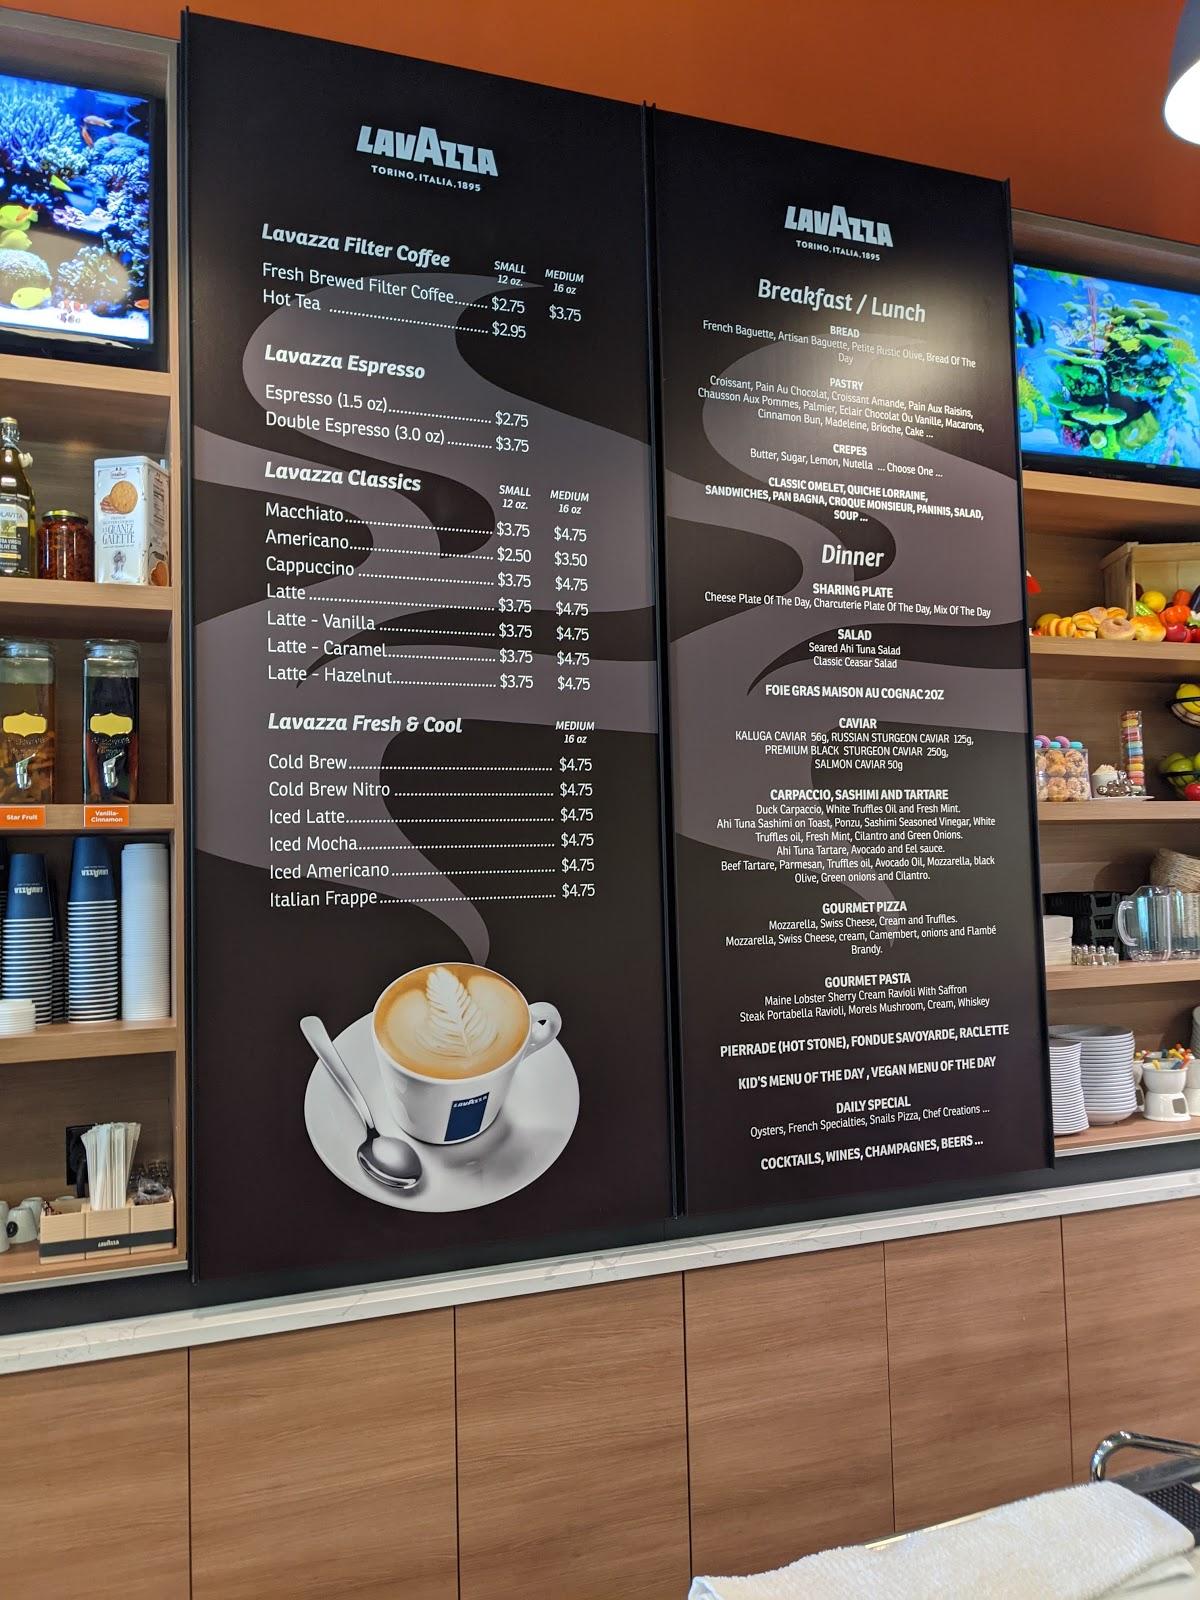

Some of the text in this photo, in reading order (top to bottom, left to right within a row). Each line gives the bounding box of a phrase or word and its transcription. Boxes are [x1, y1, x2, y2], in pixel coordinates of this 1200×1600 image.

[356, 125, 498, 177] LAVAZZA
[784, 205, 894, 248] LAVAZZA
[262, 223, 450, 268] Lavazza Filter Coffee
[494, 260, 526, 274] SMALL
[263, 262, 407, 296] Fresh Brewed Filter
[545, 269, 584, 283] MEDIUM
[263, 288, 321, 310] Hot Tea
[492, 296, 525, 314] $2.75
[758, 278, 925, 322] Breakfast Lunch
[549, 304, 582, 322] $3.75
[492, 320, 526, 338] $2.95
[830, 325, 860, 338] BREAD
[264, 344, 425, 379] Lavazza Espresso
[830, 377, 864, 391] PASTRY
[266, 384, 363, 409] Espresso (1.5
[266, 411, 421, 441] Double Espresso (3.0
[495, 410, 529, 428] $2.75
[496, 435, 529, 452] $3.75
[833, 444, 868, 456] CREPES
[265, 462, 421, 491] Lavazza Classics
[499, 484, 531, 497] SMALL
[550, 490, 589, 502] MEDIUM
[705, 484, 984, 520] SANDWICHES, PAN BAGNA, CROQUE MONSIEUR, PANINIS, SALAD,
[496, 520, 530, 538] $3.75
[554, 526, 587, 542] $4.75
[497, 546, 532, 563] $2.50
[554, 550, 588, 567] $3.50
[822, 544, 885, 567] Dinner
[266, 556, 354, 576] Cappuccino
[498, 571, 531, 588] $3.75
[555, 576, 588, 592] $4.75
[267, 583, 306, 600] Latte
[812, 583, 894, 598] SHARING PLATE
[498, 597, 532, 613] $3.75
[556, 600, 589, 616] $4.75
[268, 610, 376, 630] Latte Vanilla
[499, 622, 532, 638] $3.75
[556, 625, 589, 641] $4.75
[838, 628, 872, 641] SALAD
[268, 638, 306, 654] Latte
[499, 648, 533, 664] $3.75
[557, 650, 590, 666] $4.75
[813, 656, 898, 668] Classic Ceasar Salad
[268, 665, 307, 681] Latte
[500, 673, 534, 689] $3.75
[558, 675, 590, 691] $4.75
[766, 684, 944, 700] FOIE GRAS MAISON AU COGNAC 2OZ
[268, 712, 462, 733] Lavazza Fresh Cool
[555, 721, 595, 731] MEDIUM
[839, 717, 877, 729] CAVIAR
[269, 754, 303, 769] Cold
[559, 756, 592, 772] $4.75
[814, 758, 903, 772] SALMON CAVIAR 50g
[269, 781, 390, 796] Cold Brew Nitro
[560, 782, 593, 798] $4.75
[770, 789, 949, 802] CARPACCIO, SASHIMI AND TARTARE
[270, 809, 300, 824] Iced
[560, 807, 594, 823] $4.75
[270, 836, 301, 852] Iced
[561, 832, 594, 848] $4.75
[270, 863, 389, 880] Iced Americano
[562, 857, 594, 874] $4.75
[562, 882, 595, 898] $4.75
[270, 890, 377, 908] Italian Frappe
[822, 900, 907, 914] GOURMET PIZZA
[825, 972, 911, 988] GOURMET PASTA
[764, 984, 967, 1006] Maine Lobster Sherry Cream Ravioli With Saffron
[720, 1024, 1010, 1057] PIERRADE (HOT STONE), FONDUE SAVOYARDE, RACLETTE
[738, 1056, 996, 1090] KID'S MENU OF THE DAY VEGAN MENU OF THE DAY
[453, 1095, 487, 1108] LAVAZZA
[836, 1096, 911, 1114] DAILY SPECIAL
[761, 1134, 973, 1170] COCKTAILS, WINES, CHAMPAGNES, BEERS
